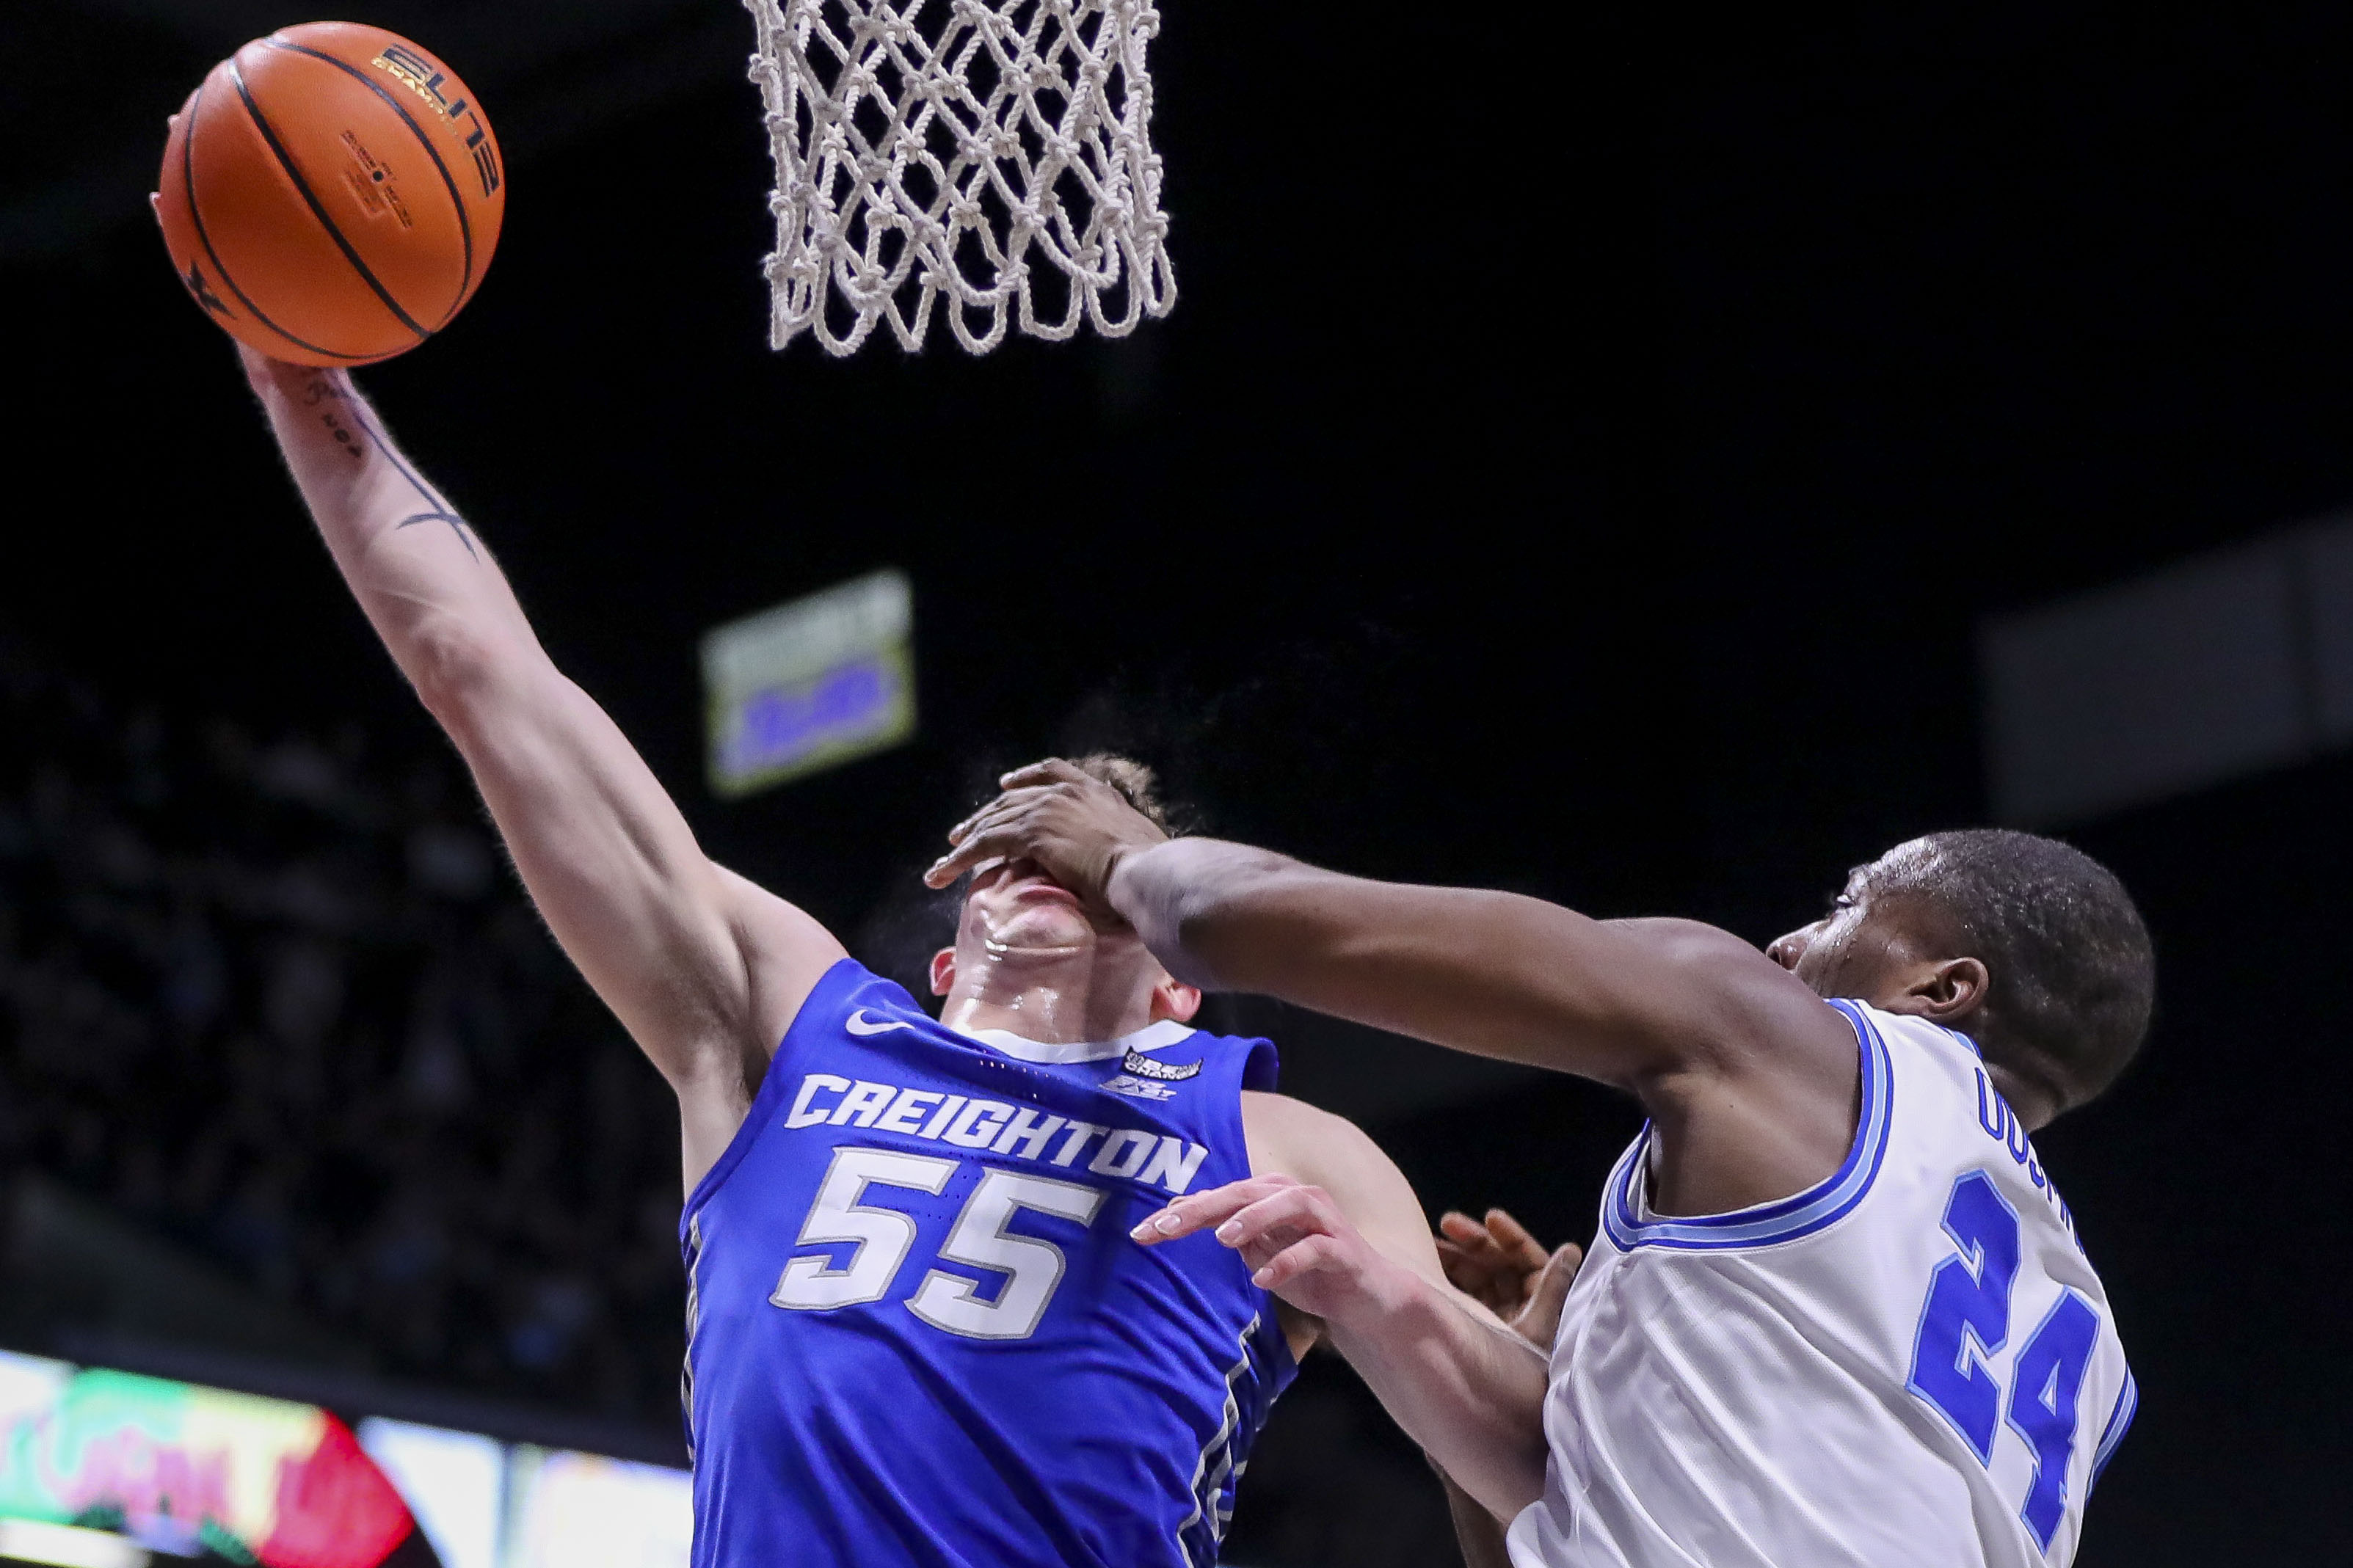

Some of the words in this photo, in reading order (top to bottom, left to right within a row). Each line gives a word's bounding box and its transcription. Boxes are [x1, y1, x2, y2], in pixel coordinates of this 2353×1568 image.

[784, 1073, 1210, 1195] CREIGHTON
[768, 1146, 1110, 1341] 55
[1905, 1168, 2101, 1558] 24
